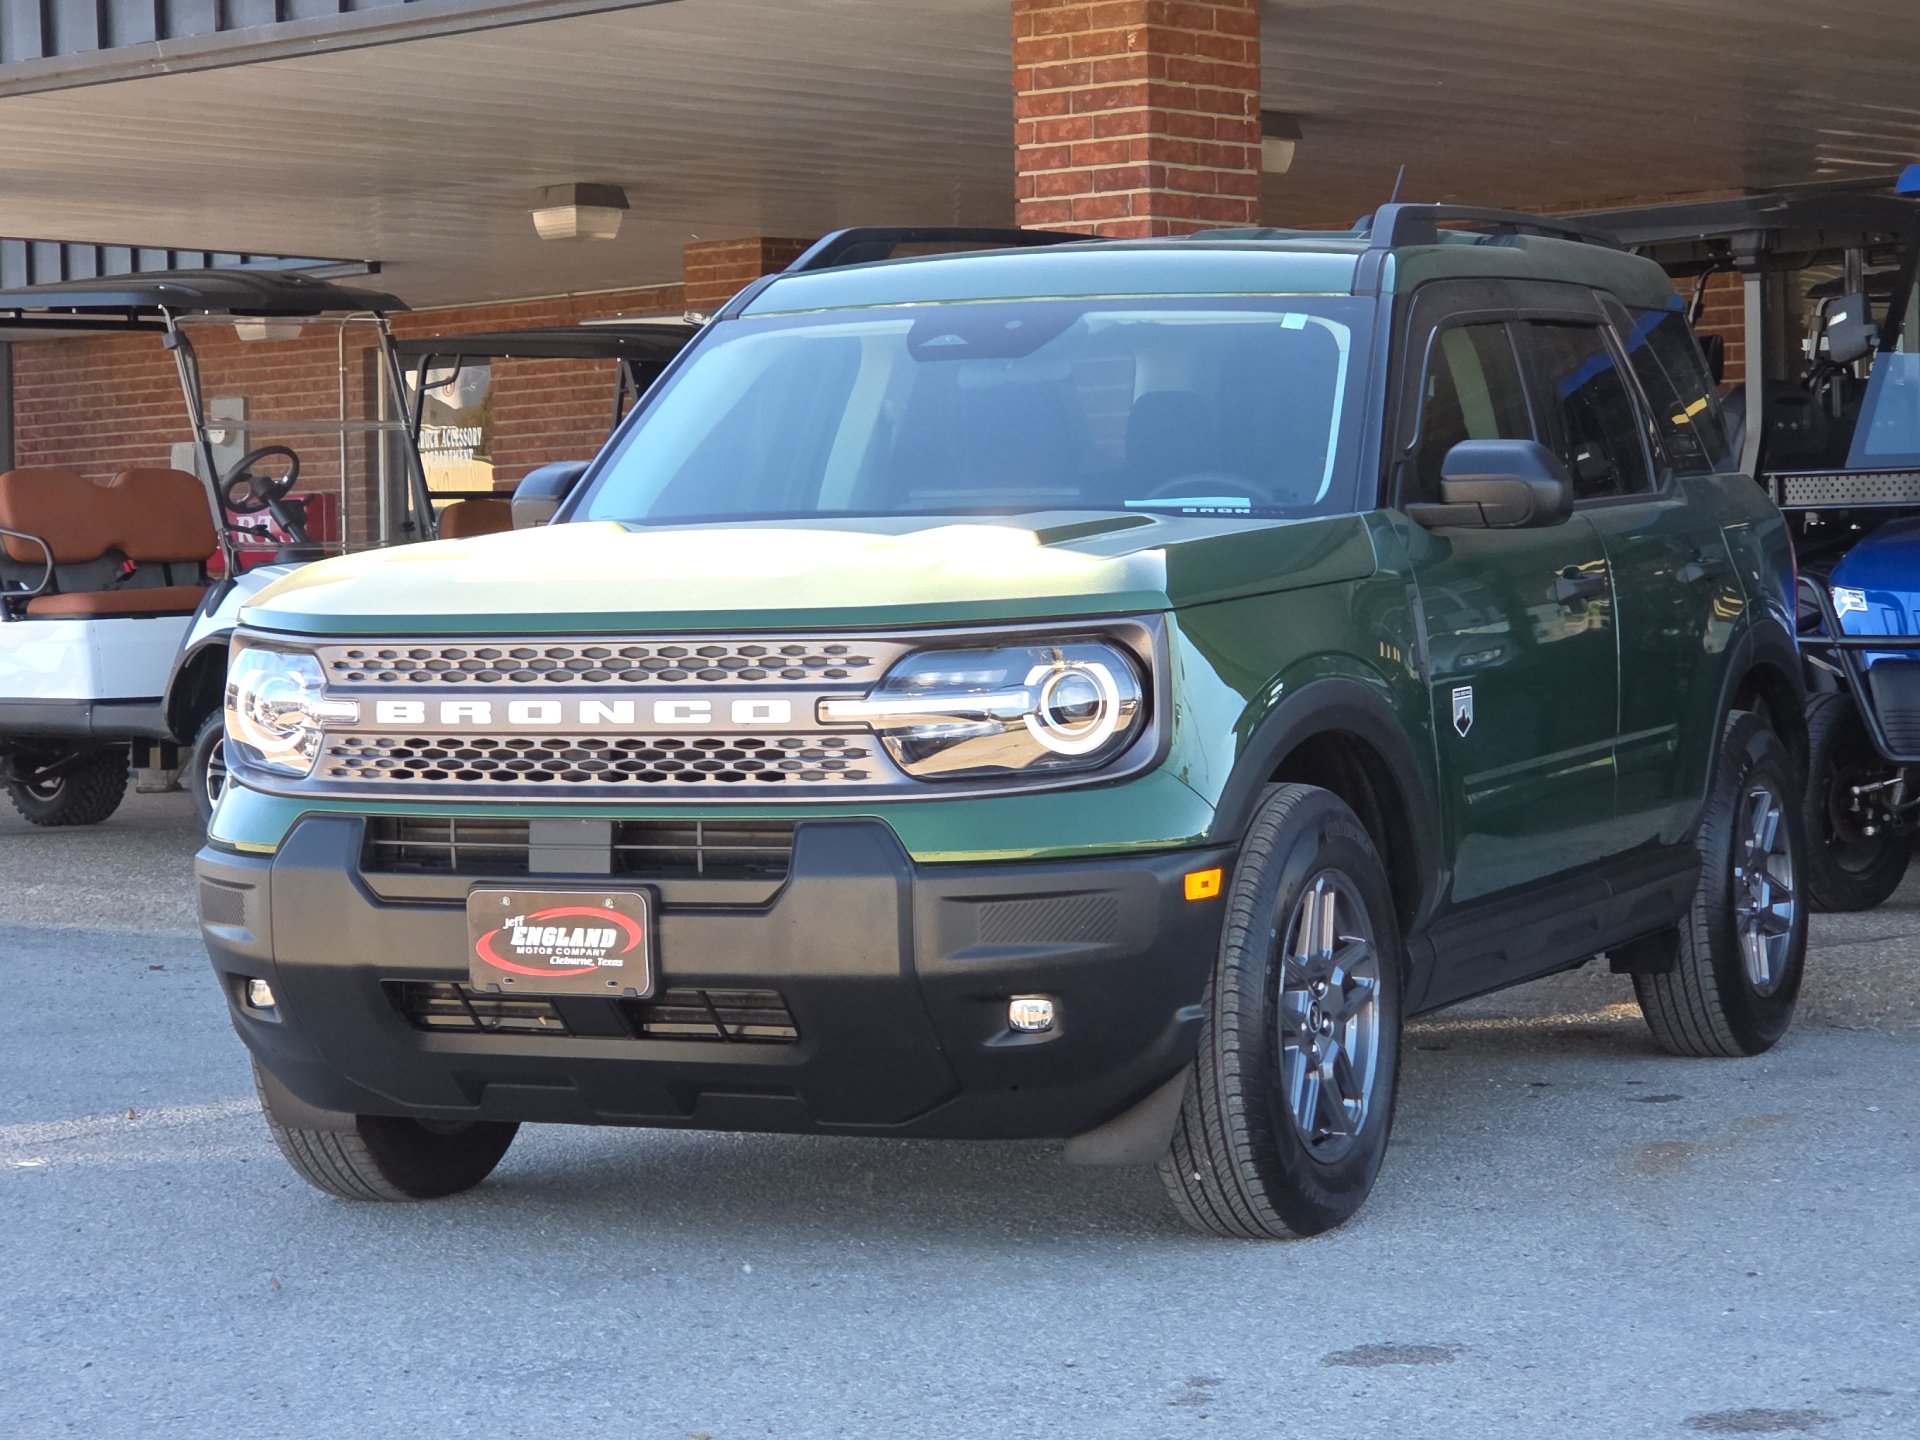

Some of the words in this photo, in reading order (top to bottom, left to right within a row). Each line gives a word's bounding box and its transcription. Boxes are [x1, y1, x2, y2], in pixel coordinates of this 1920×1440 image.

[441, 427, 482, 447] ACCESSORY
[424, 448, 473, 467] DEPARTMENT
[375, 699, 792, 725] BRONCO
[510, 927, 617, 947] ENGLAND
[516, 947, 553, 955] MOTOR
[555, 948, 606, 956] COMPANY
[550, 956, 595, 966] Cleburne,
[597, 957, 624, 967] Texas
